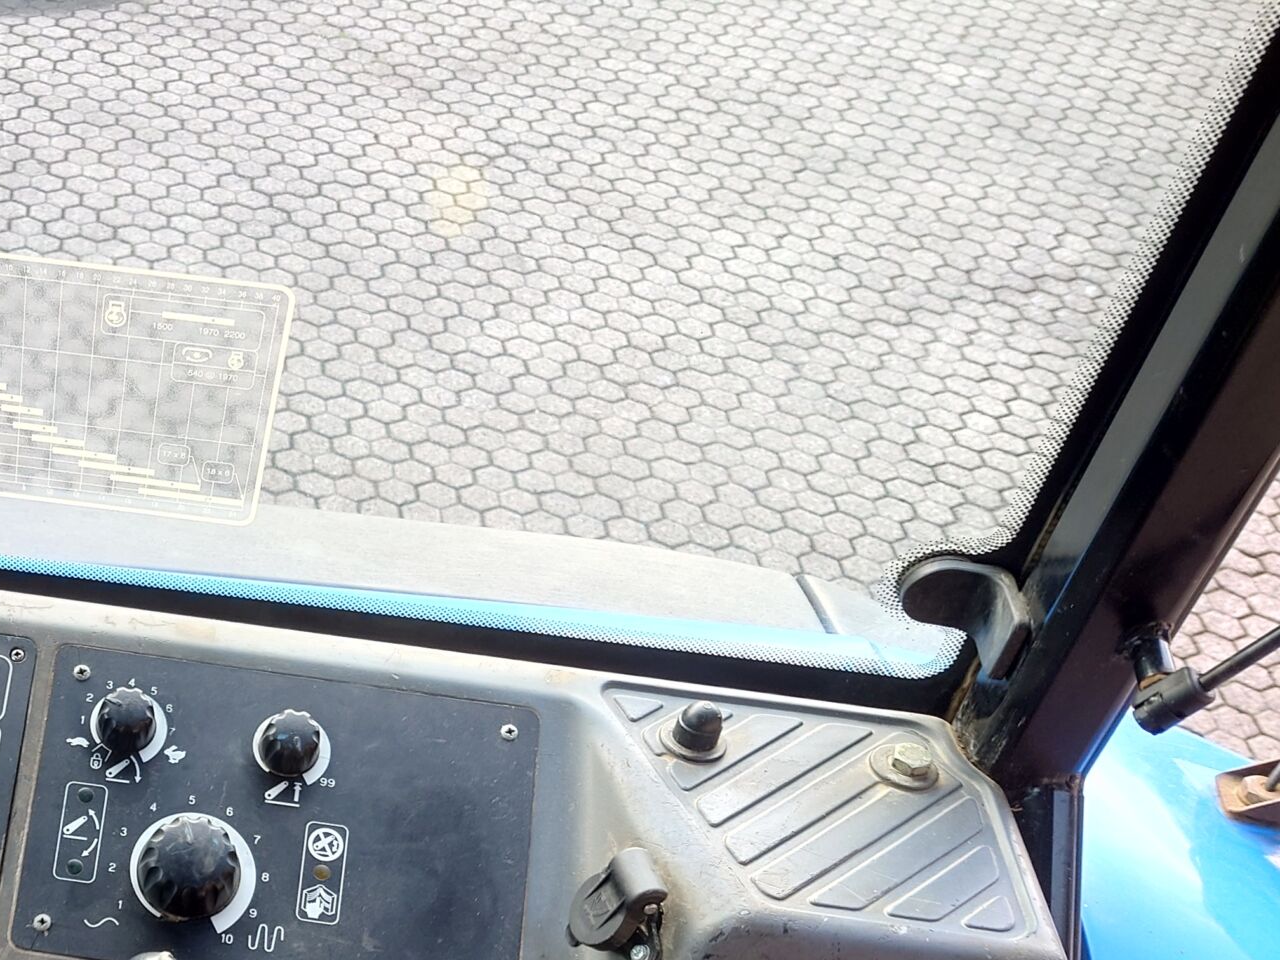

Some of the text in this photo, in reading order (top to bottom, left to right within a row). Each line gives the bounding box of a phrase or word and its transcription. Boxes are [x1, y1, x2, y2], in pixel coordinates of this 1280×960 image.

[272, 294, 281, 302] 40
[152, 322, 246, 340] 1500 1970 2200
[188, 369, 204, 378] 540
[106, 681, 114, 690] 3
[128, 678, 136, 688] 4
[150, 686, 158, 696] 5
[86, 692, 94, 702] 2
[166, 704, 173, 712] 6
[80, 716, 86, 724] 1
[169, 727, 176, 736] 7
[319, 778, 336, 788] 99
[188, 795, 196, 805] 5
[150, 802, 158, 812] 4
[226, 807, 234, 816] 6
[120, 828, 128, 836] 3
[253, 835, 262, 845] 7
[108, 863, 116, 873] 2
[261, 872, 270, 882] 8
[118, 900, 123, 910] 1
[248, 908, 258, 918] 9
[221, 934, 234, 944] 10
